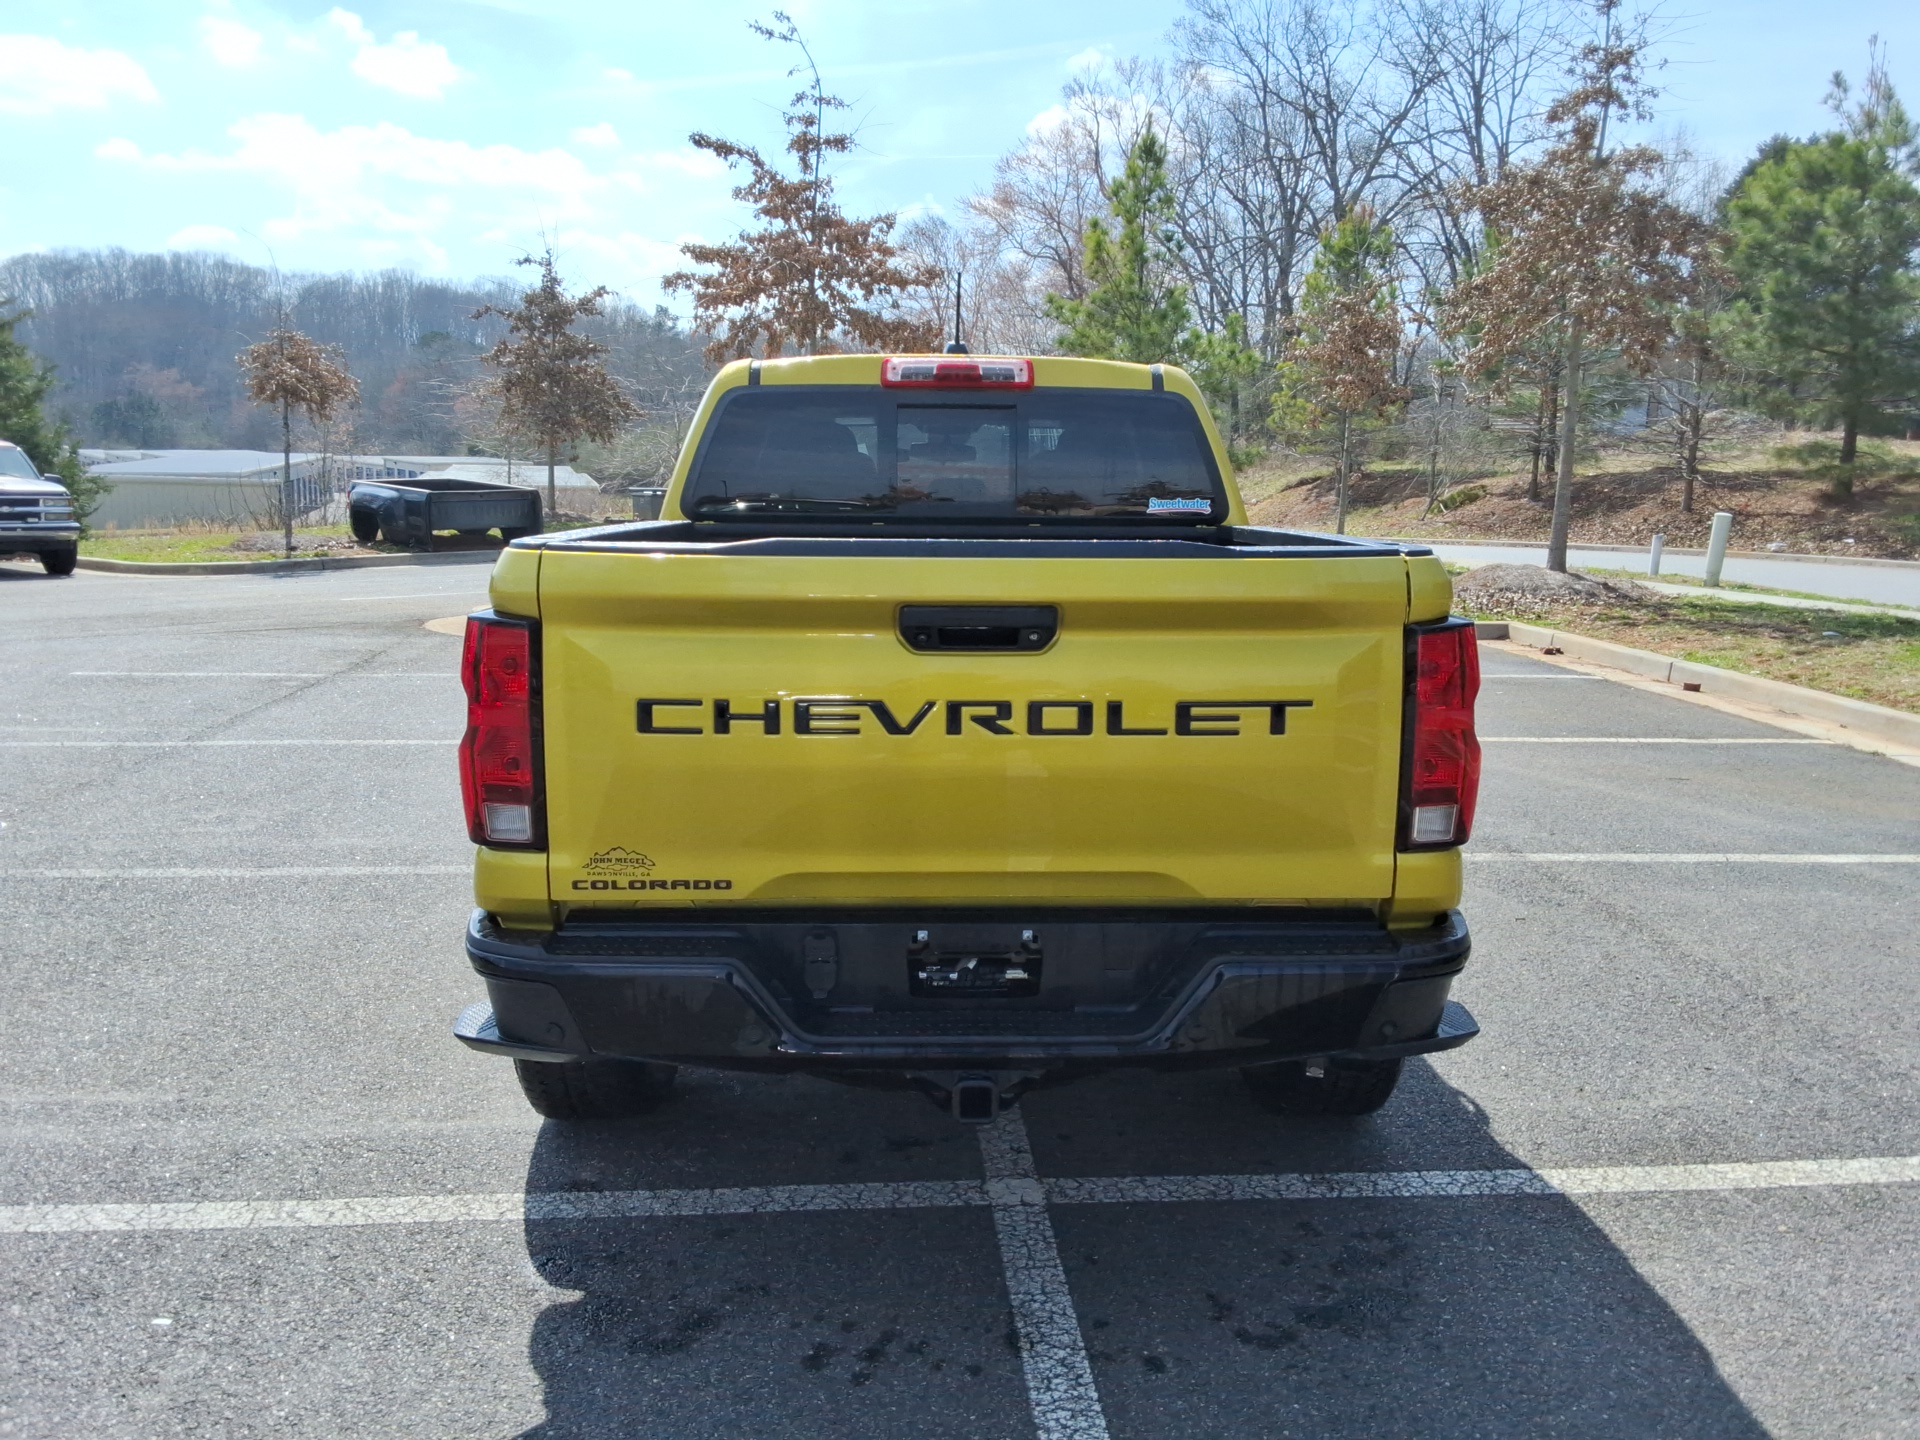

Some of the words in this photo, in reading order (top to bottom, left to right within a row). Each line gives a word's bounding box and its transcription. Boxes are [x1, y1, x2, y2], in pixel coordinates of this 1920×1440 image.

[1150, 498, 1209, 509] Sweetwater
[636, 698, 1313, 736] CHEVROLET
[589, 857, 612, 866] JOHN
[615, 857, 647, 866] MEGEL
[572, 880, 732, 890] COLORADO
